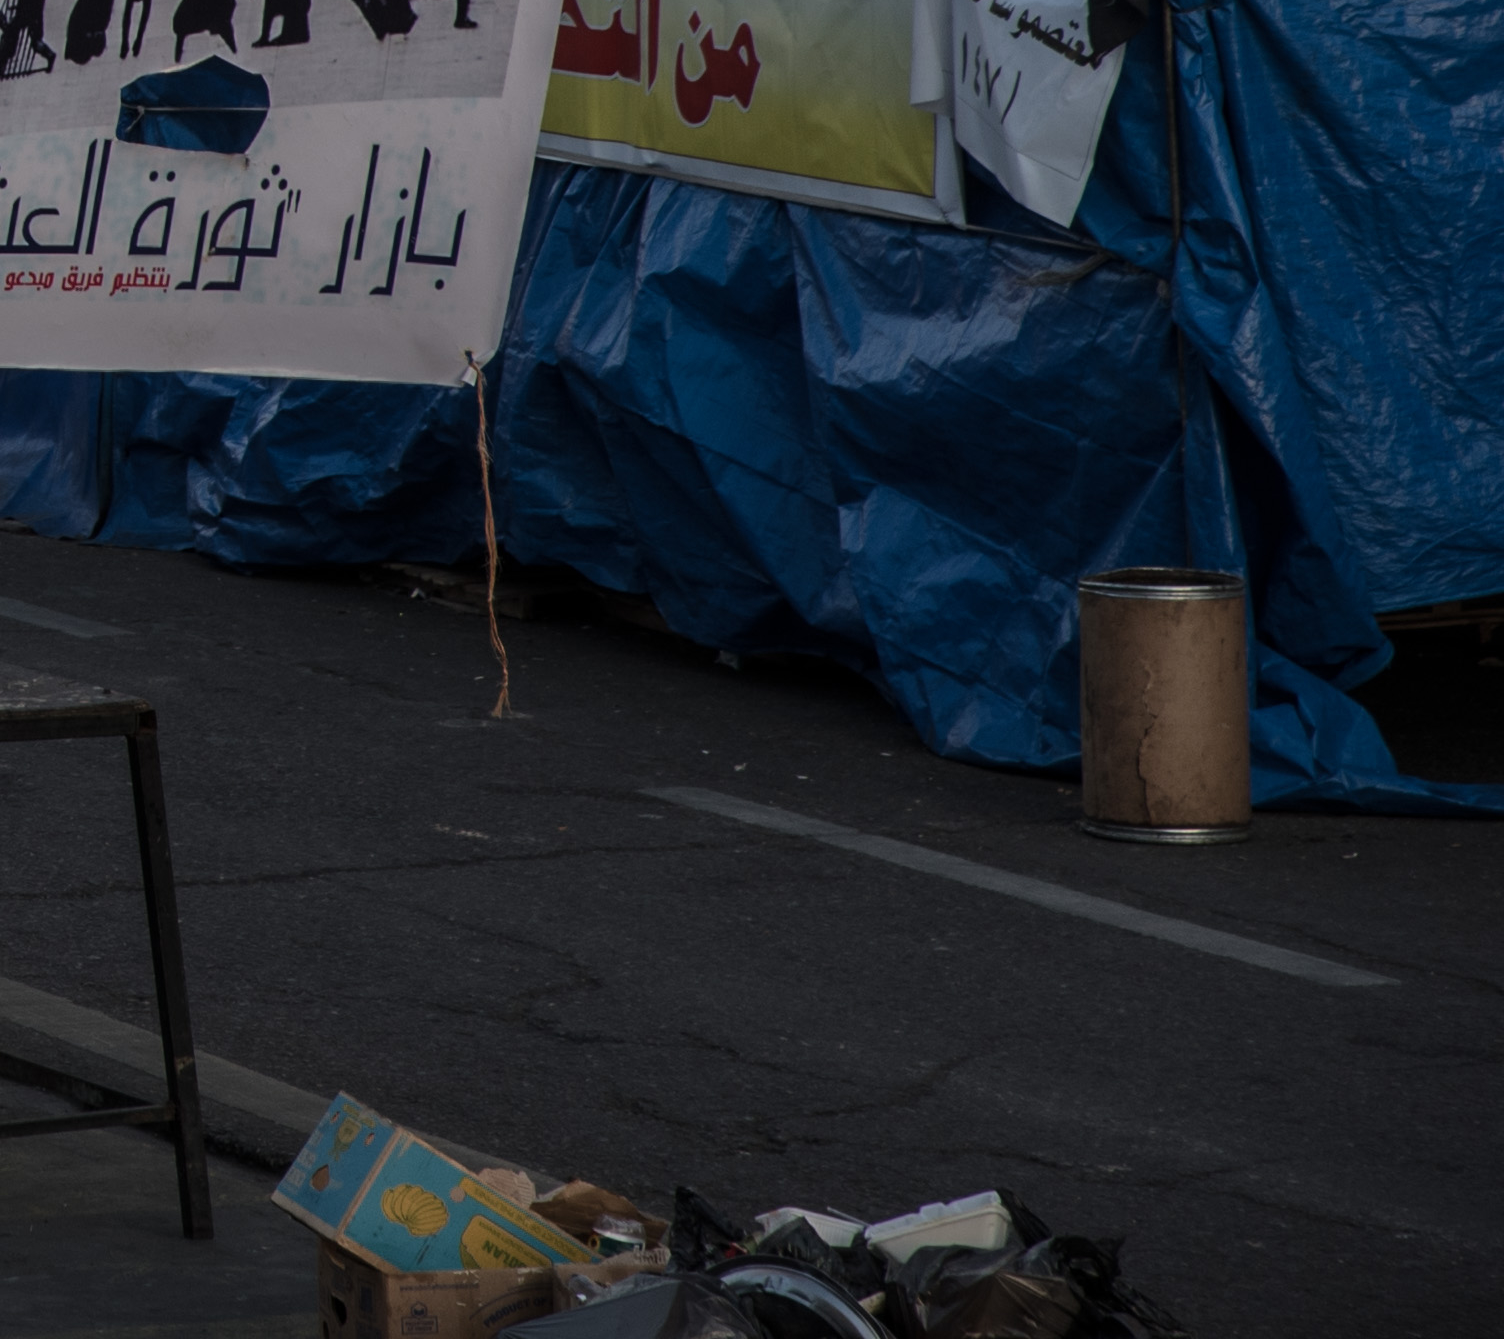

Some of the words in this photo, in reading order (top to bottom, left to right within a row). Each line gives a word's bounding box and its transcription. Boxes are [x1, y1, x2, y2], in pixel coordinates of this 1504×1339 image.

[674, 9, 762, 126] من
[318, 143, 467, 297] بازار
[3, 265, 54, 294] مبدعو
[62, 266, 104, 294] فريق
[109, 268, 172, 297] بتنظيم
[483, 1297, 530, 1328] PRODUCT
